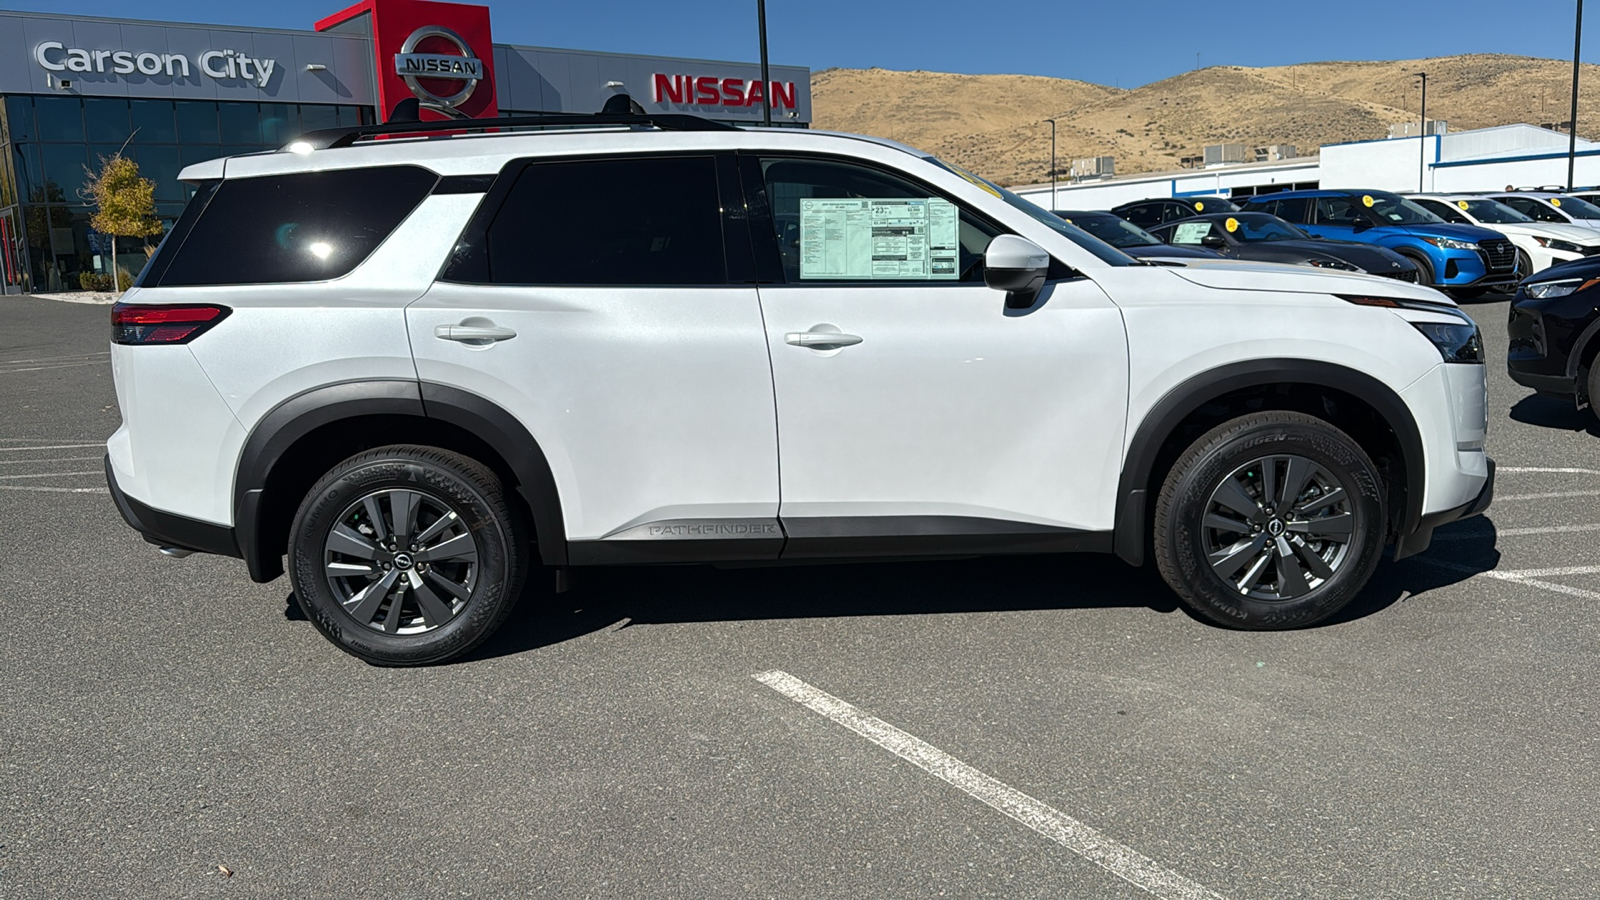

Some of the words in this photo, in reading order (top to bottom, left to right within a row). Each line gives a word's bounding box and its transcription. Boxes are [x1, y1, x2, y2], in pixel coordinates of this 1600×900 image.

[34, 40, 190, 76] Carson
[199, 49, 275, 87] City
[406, 58, 477, 75] NISSAN
[652, 73, 796, 109] NISSAN
[1224, 433, 1288, 460] CRUGEN
[303, 490, 339, 540] KUMHO
[649, 524, 778, 536] PATHFINDER
[1198, 585, 1249, 620] KUMHO
